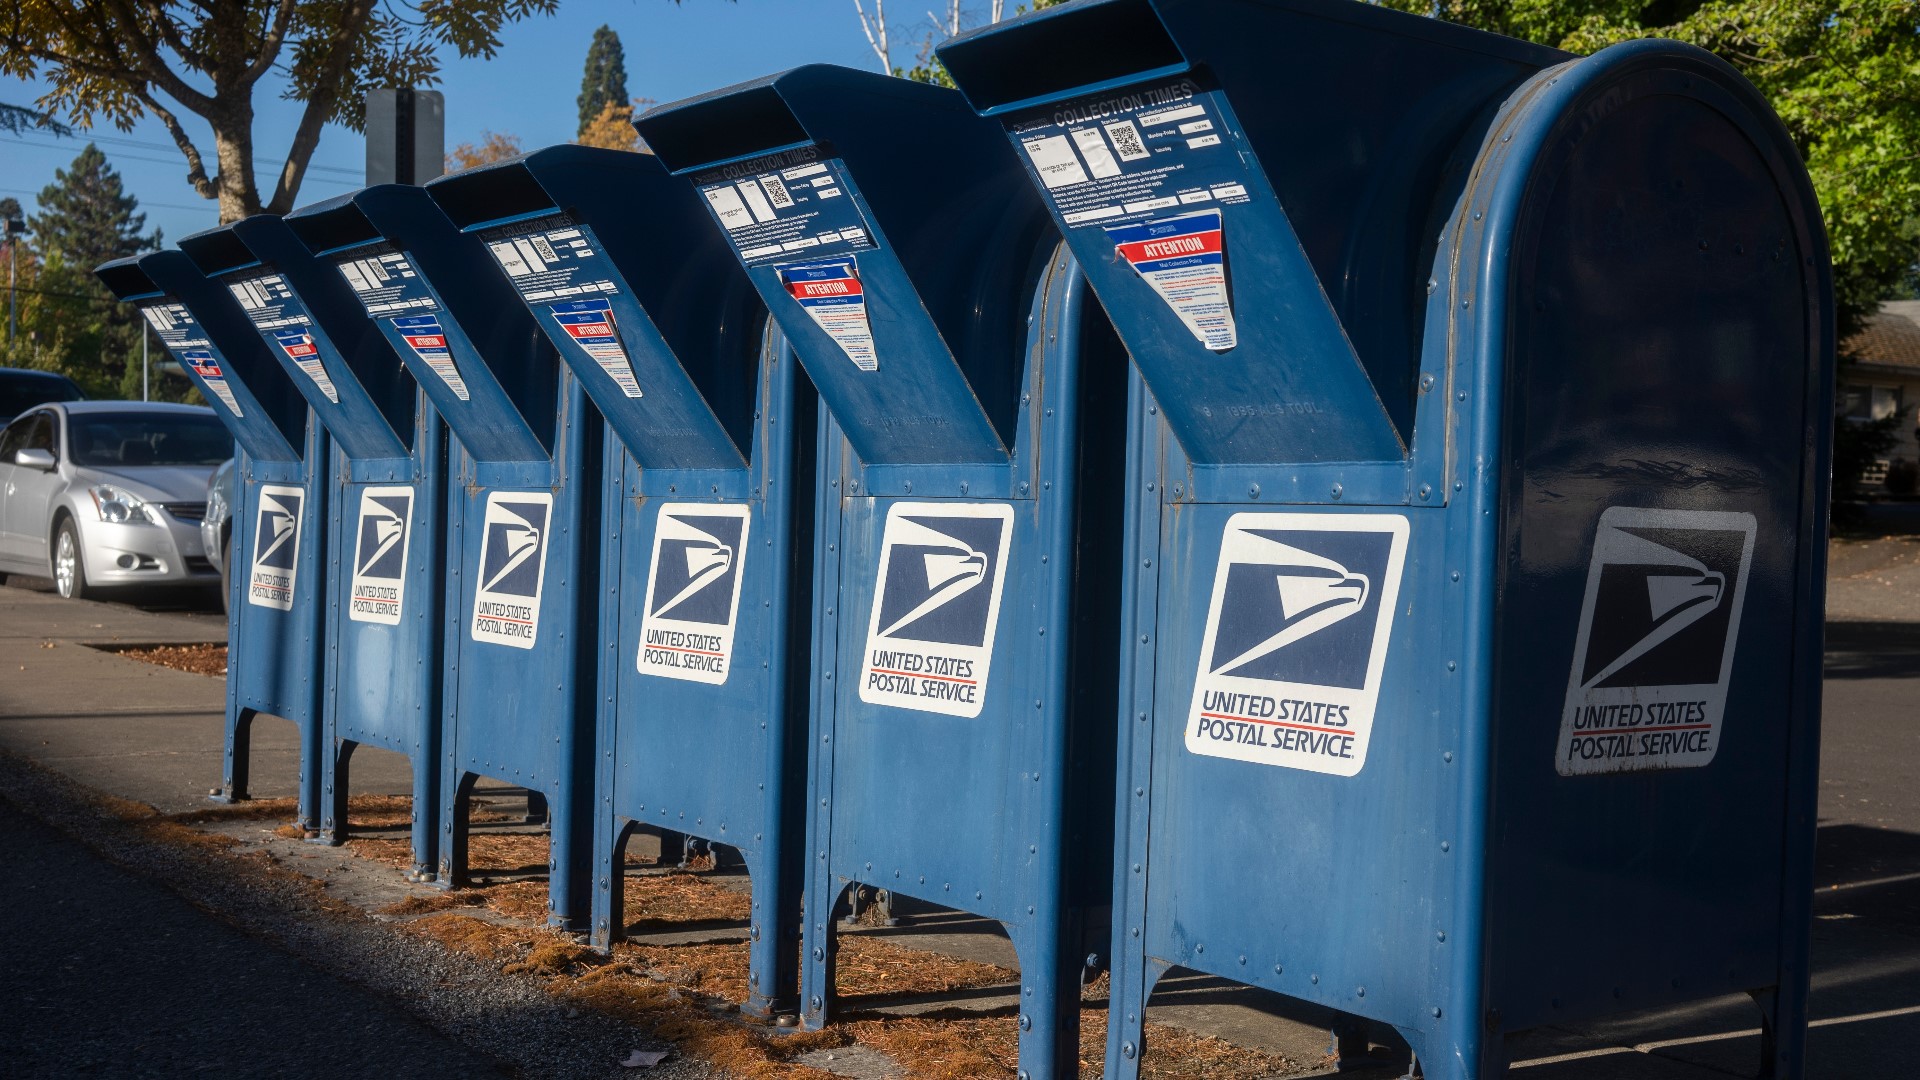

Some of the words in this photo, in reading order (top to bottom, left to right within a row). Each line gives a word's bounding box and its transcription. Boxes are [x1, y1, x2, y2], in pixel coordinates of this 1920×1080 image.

[1054, 94, 1144, 127] COLLECTION
[1145, 83, 1192, 106] TIMES
[723, 154, 785, 179] COLLECTION
[785, 146, 817, 164] TIMES
[1144, 237, 1204, 258] ATTENTION
[804, 282, 848, 295] ATTENTION
[577, 325, 609, 336] ATTENTION
[254, 572, 272, 585] UNITED
[273, 575, 290, 588] STATES
[252, 586, 270, 598] POSTAL
[355, 585, 376, 598] UNITED
[377, 587, 397, 600] STATES
[353, 600, 374, 613] POSTAL
[375, 602, 398, 616] SERVICE
[478, 601, 505, 617] UNITED
[506, 604, 531, 620] STATES
[476, 619, 502, 634] POSTAL
[503, 622, 532, 638] SERVICE
[646, 629, 685, 647] UNITED
[686, 634, 722, 651] STATES
[643, 649, 680, 667] POSTAL
[682, 653, 724, 673] SERVICE
[872, 650, 923, 671] UNITED
[924, 656, 974, 677] STATES
[868, 673, 918, 696] POSTAL
[920, 680, 977, 703] SERVICE
[1203, 690, 1275, 717] UNITED
[1278, 699, 1350, 727] STATES
[1574, 704, 1643, 729] UNITED
[1645, 701, 1706, 726] STATES
[1197, 718, 1267, 747] POSTAL
[1271, 728, 1354, 759] SERVICE
[1568, 735, 1635, 760] POSTAL
[1639, 730, 1710, 755] SERVICE
